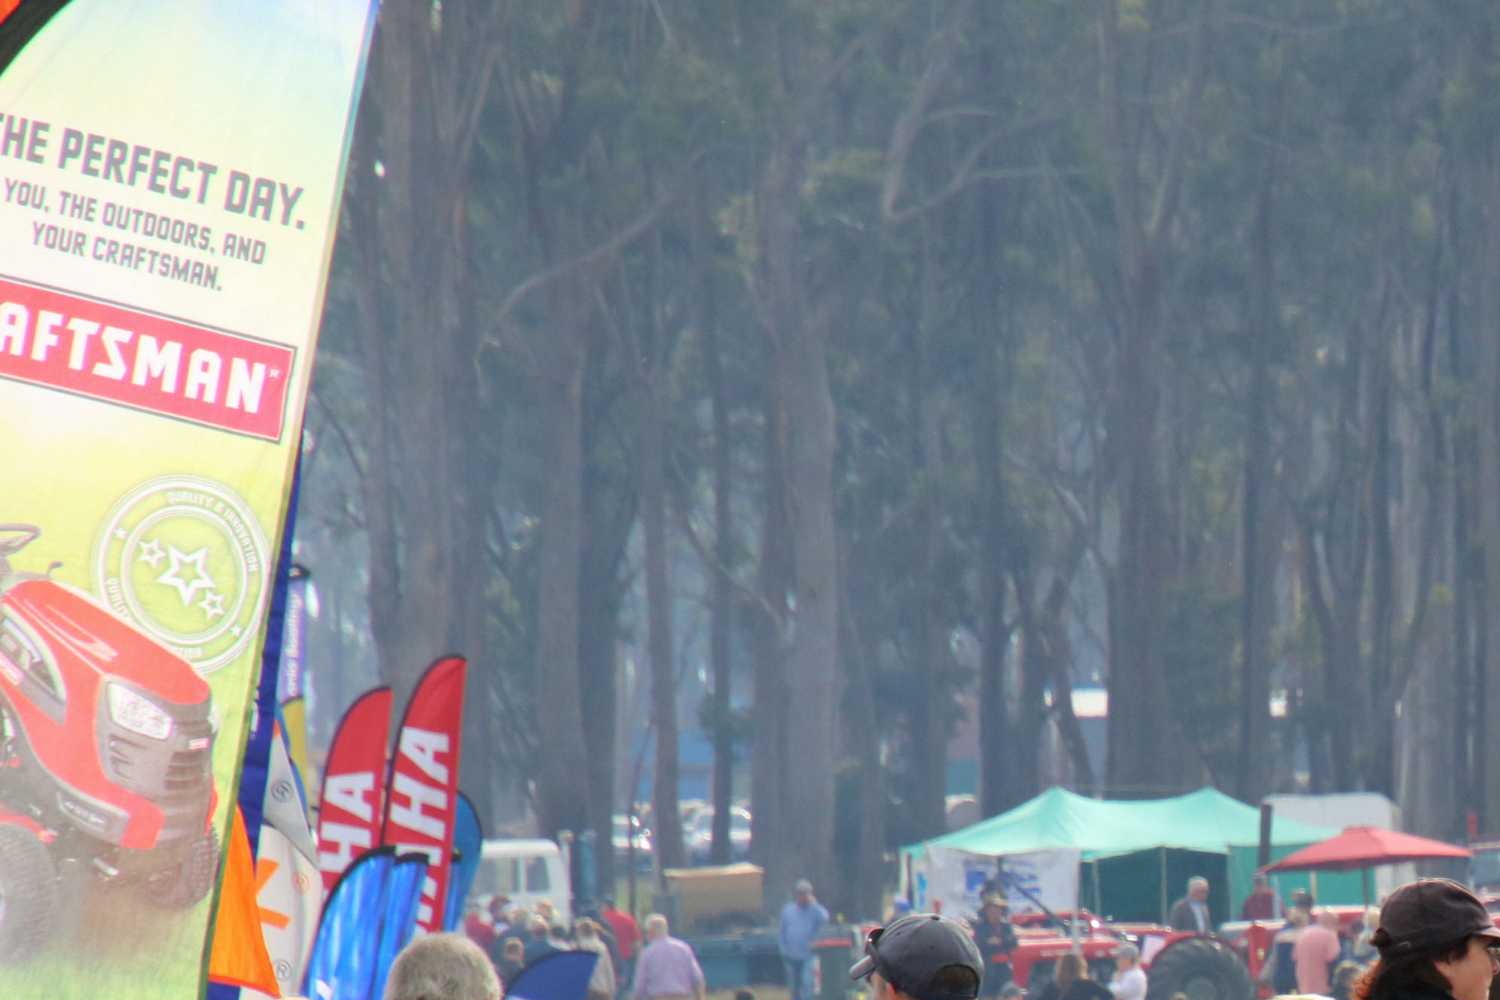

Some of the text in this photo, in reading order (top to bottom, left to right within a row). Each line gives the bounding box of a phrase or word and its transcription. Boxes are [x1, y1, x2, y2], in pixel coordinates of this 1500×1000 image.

[58, 127, 218, 204] PERFECT
[223, 170, 305, 230] DAY.
[33, 220, 223, 292] YOUR CRAFTSMAN.
[59, 190, 97, 222] THE
[222, 233, 266, 265] AND
